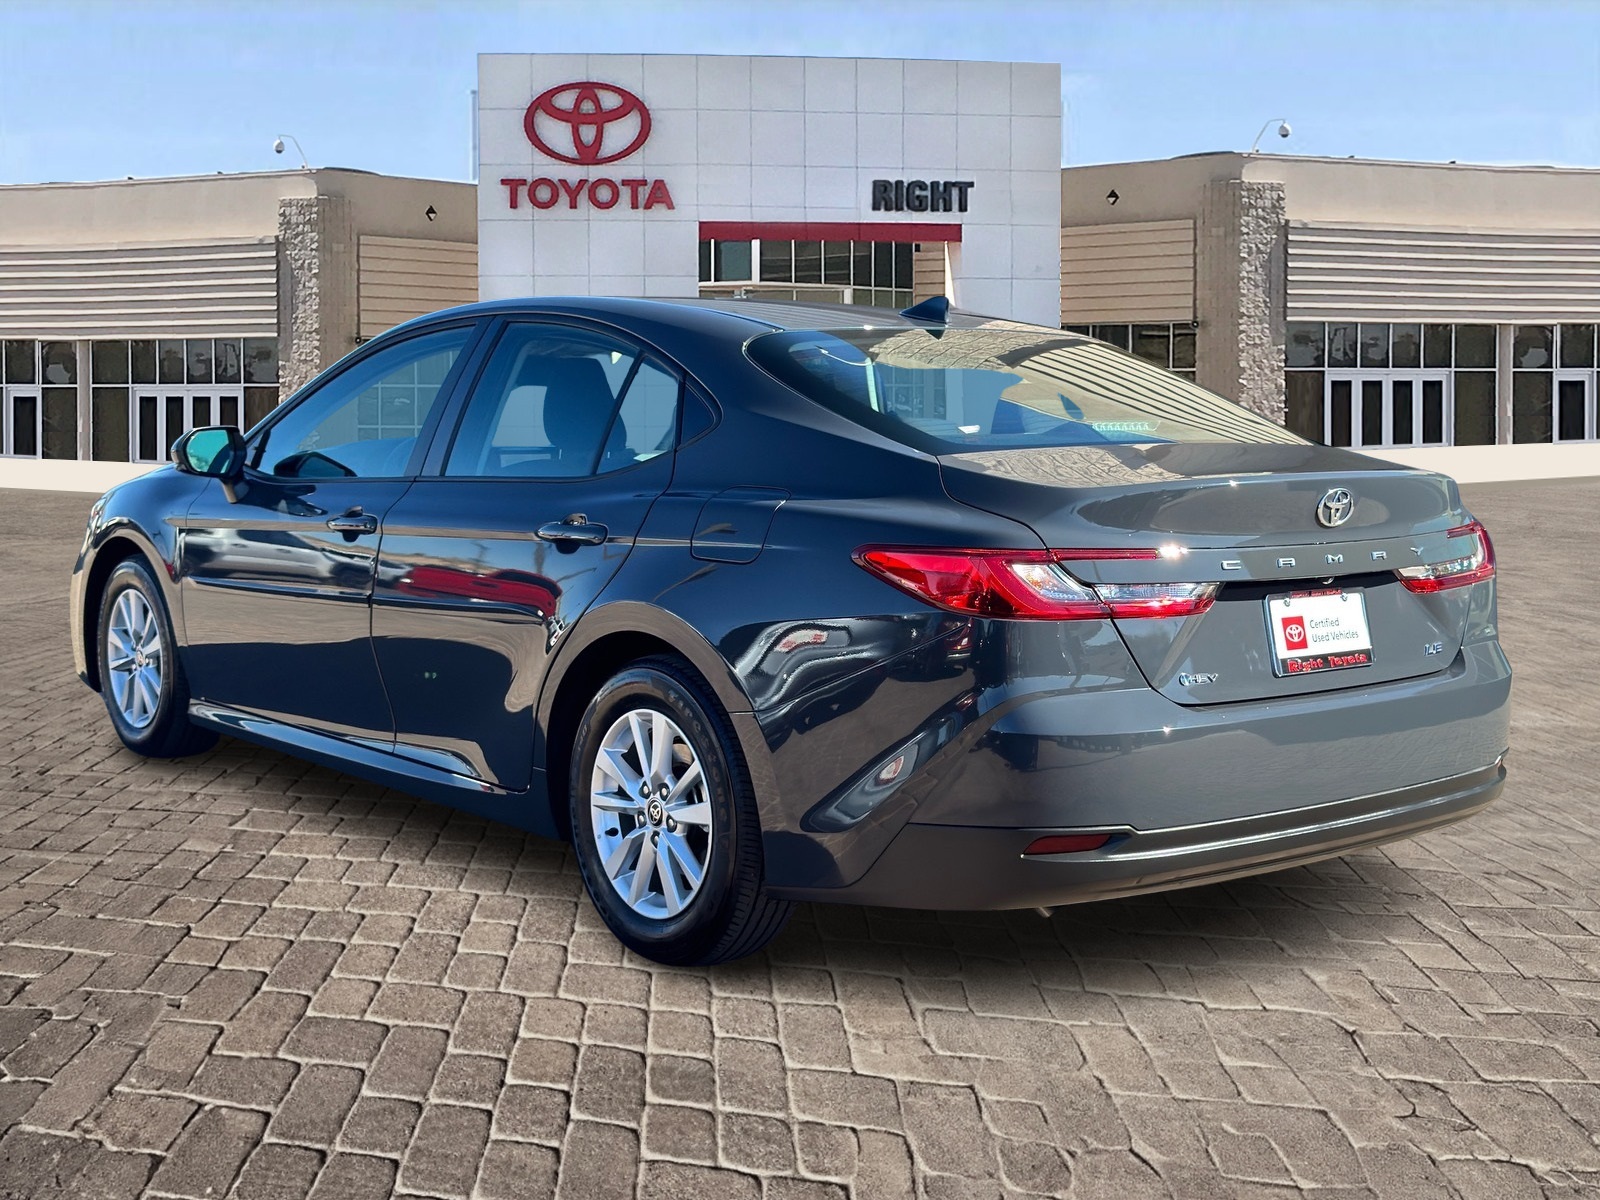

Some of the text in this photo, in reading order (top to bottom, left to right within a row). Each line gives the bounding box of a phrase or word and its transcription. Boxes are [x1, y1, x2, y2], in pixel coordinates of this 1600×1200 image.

[500, 177, 675, 210] TOYOTA
[872, 179, 975, 212] RIGHT
[1221, 546, 1424, 570] CAMRY
[1309, 617, 1340, 629] Certified
[1311, 629, 1359, 643] Used Vehicles
[1287, 653, 1367, 672] Right Toyota
